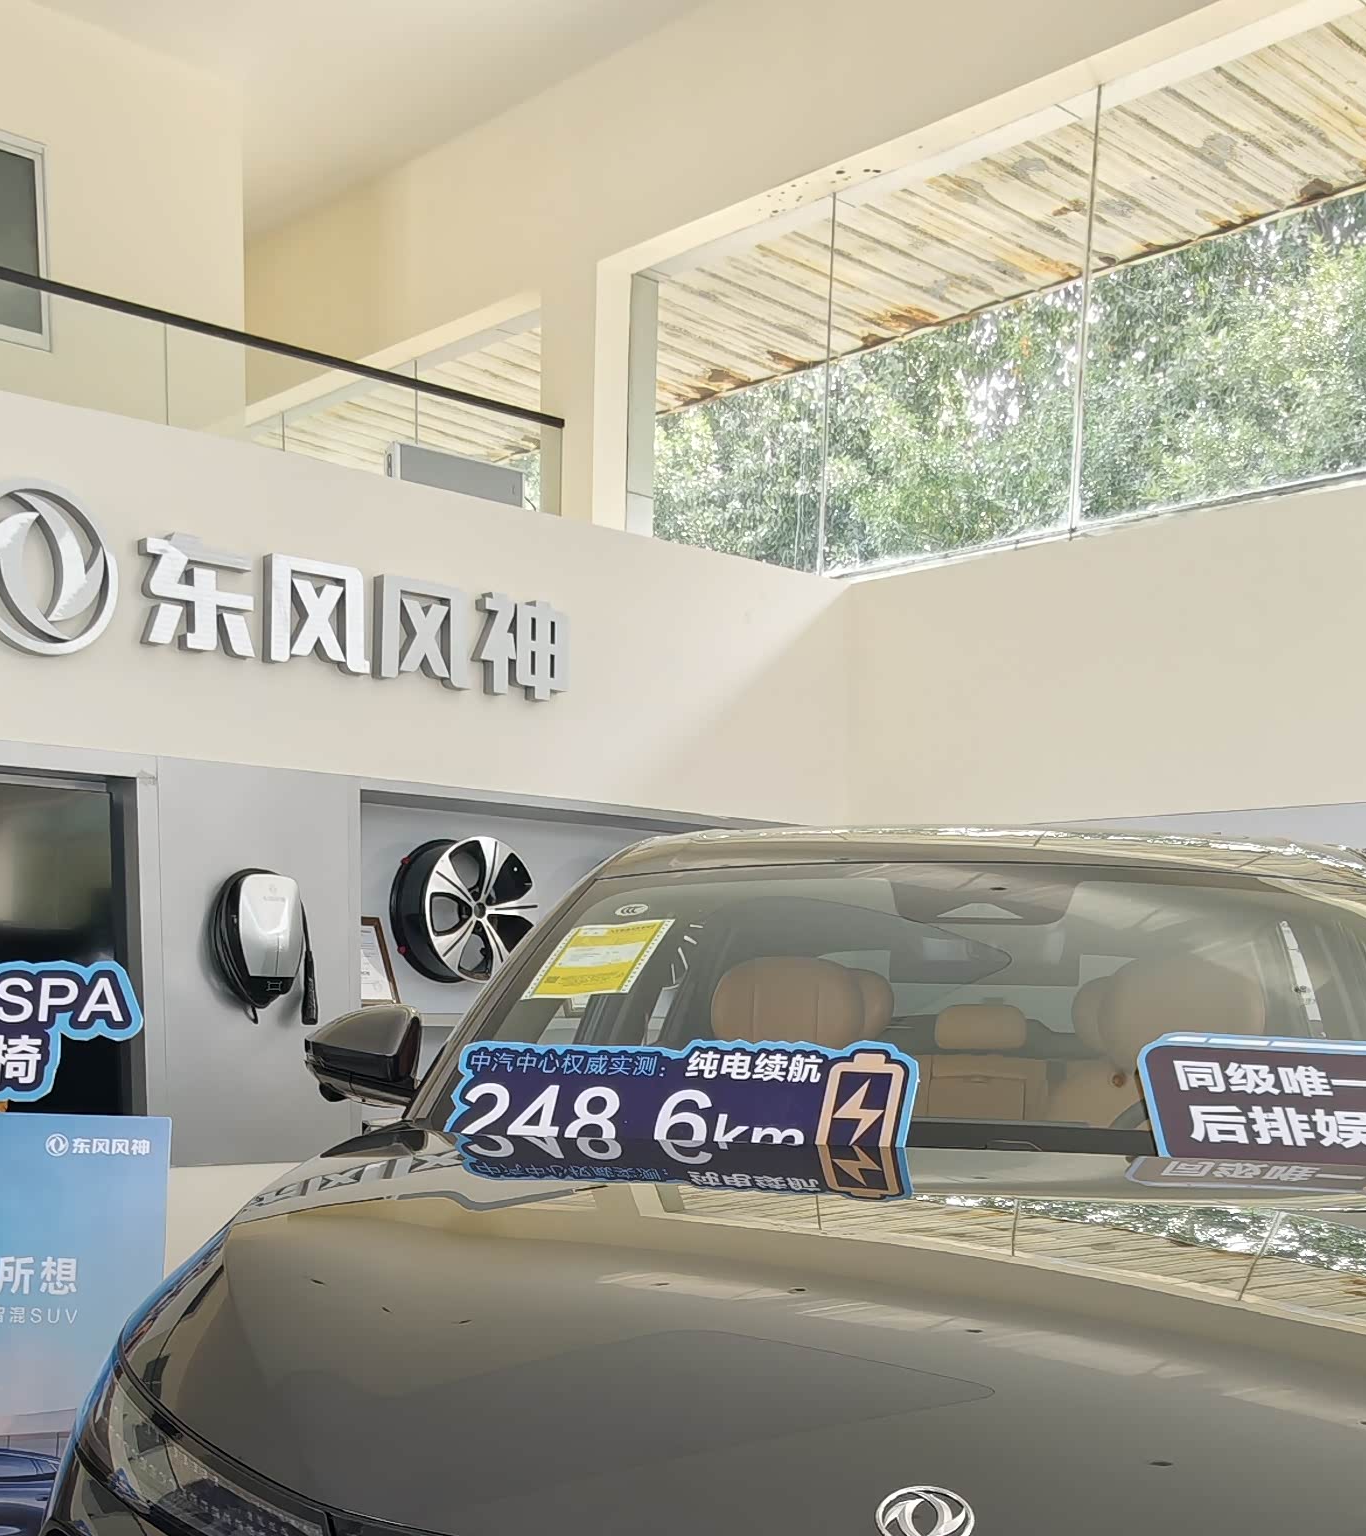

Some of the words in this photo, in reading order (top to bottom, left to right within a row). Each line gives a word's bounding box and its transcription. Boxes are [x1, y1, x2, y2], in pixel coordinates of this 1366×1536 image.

[138, 532, 568, 701] 东风风神
[685, 1050, 823, 1085] 纯电续航
[461, 1082, 805, 1145] 2486km
[71, 1138, 151, 1155] 东风风神
